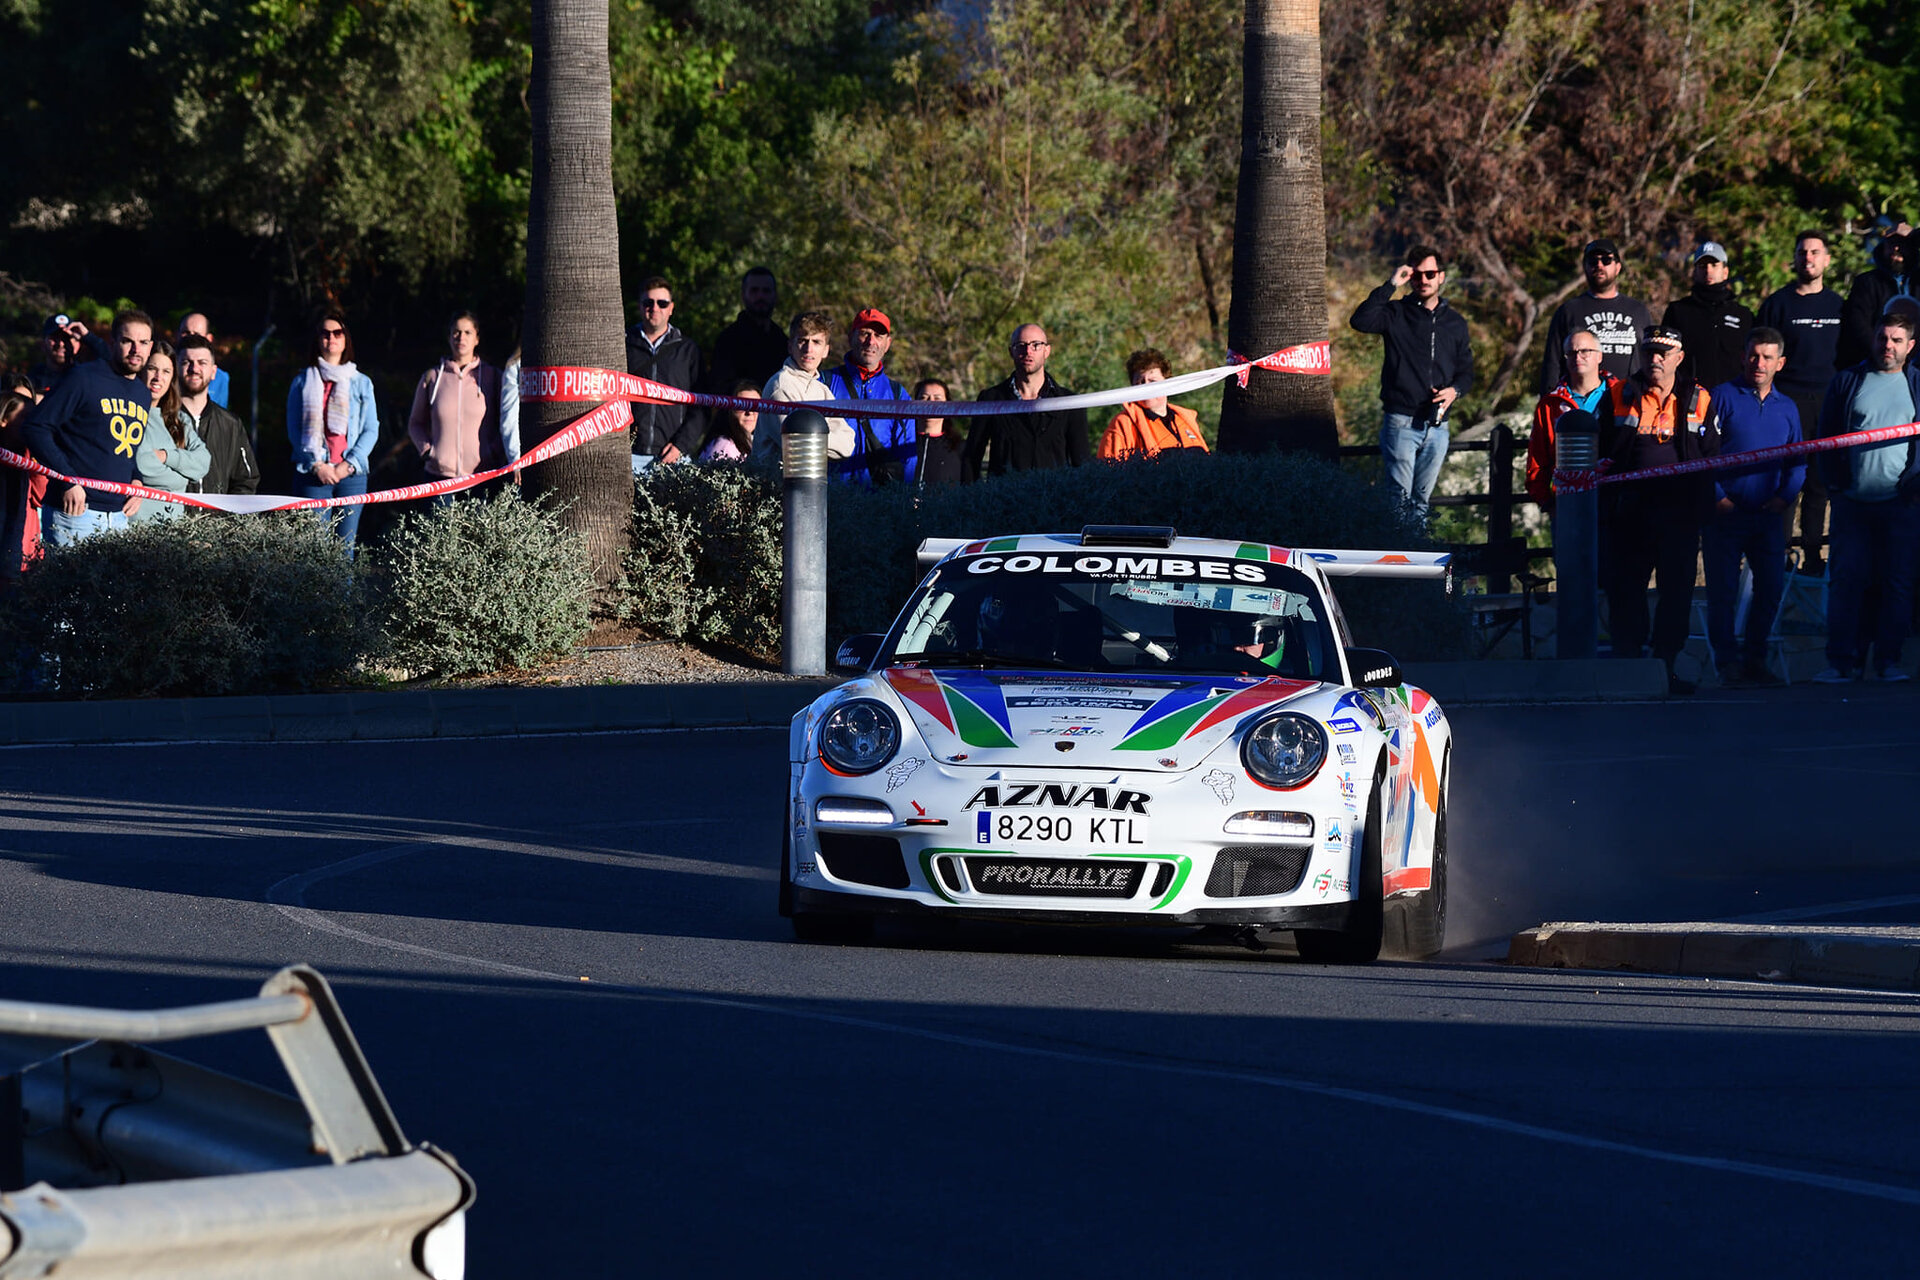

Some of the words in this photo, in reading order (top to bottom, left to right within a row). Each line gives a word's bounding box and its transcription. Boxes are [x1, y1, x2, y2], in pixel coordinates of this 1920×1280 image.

[1584, 312, 1632, 326] ADIDAS
[1262, 346, 1322, 369] PROHIBIDO
[564, 371, 616, 395] PUBLICO
[967, 555, 1267, 583] COLOMBES
[1364, 666, 1393, 683] LOURDES
[962, 782, 1152, 815] AZNAR
[979, 832, 989, 843] E
[997, 815, 1072, 843] 8290
[1089, 817, 1144, 844] KTL
[981, 864, 1133, 891] PRORALLYE
